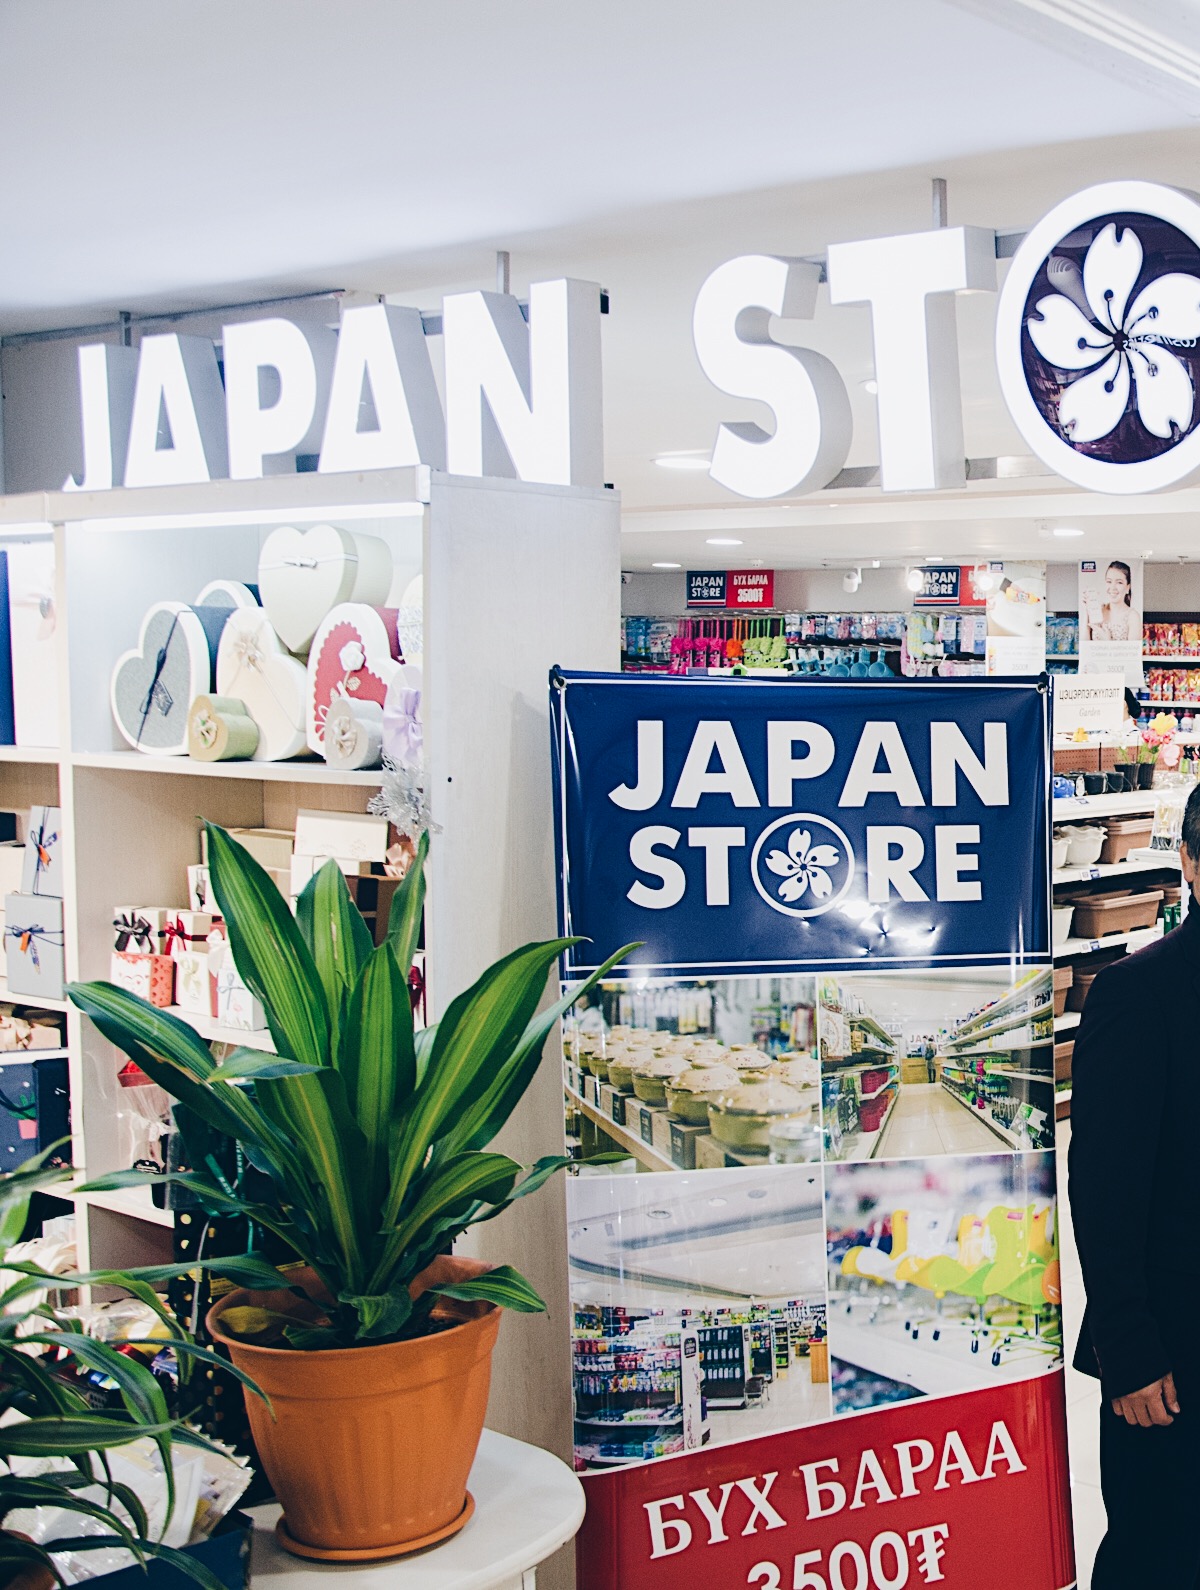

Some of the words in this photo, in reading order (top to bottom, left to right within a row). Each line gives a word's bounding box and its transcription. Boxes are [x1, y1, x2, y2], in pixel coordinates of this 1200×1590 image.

[62, 277, 585, 492] JAPAN
[691, 577, 723, 587] JAPAN
[692, 587, 720, 598] STORE
[748, 575, 768, 585] БАРАА
[923, 571, 956, 583] APAN
[1079, 707, 1101, 717] Garden
[607, 720, 1010, 811] JAPAN
[626, 813, 983, 917] STORE
[643, 1471, 788, 1560] БҮХ
[799, 1420, 1027, 1521] БАРАА
[747, 1523, 949, 1590] 3500₮
